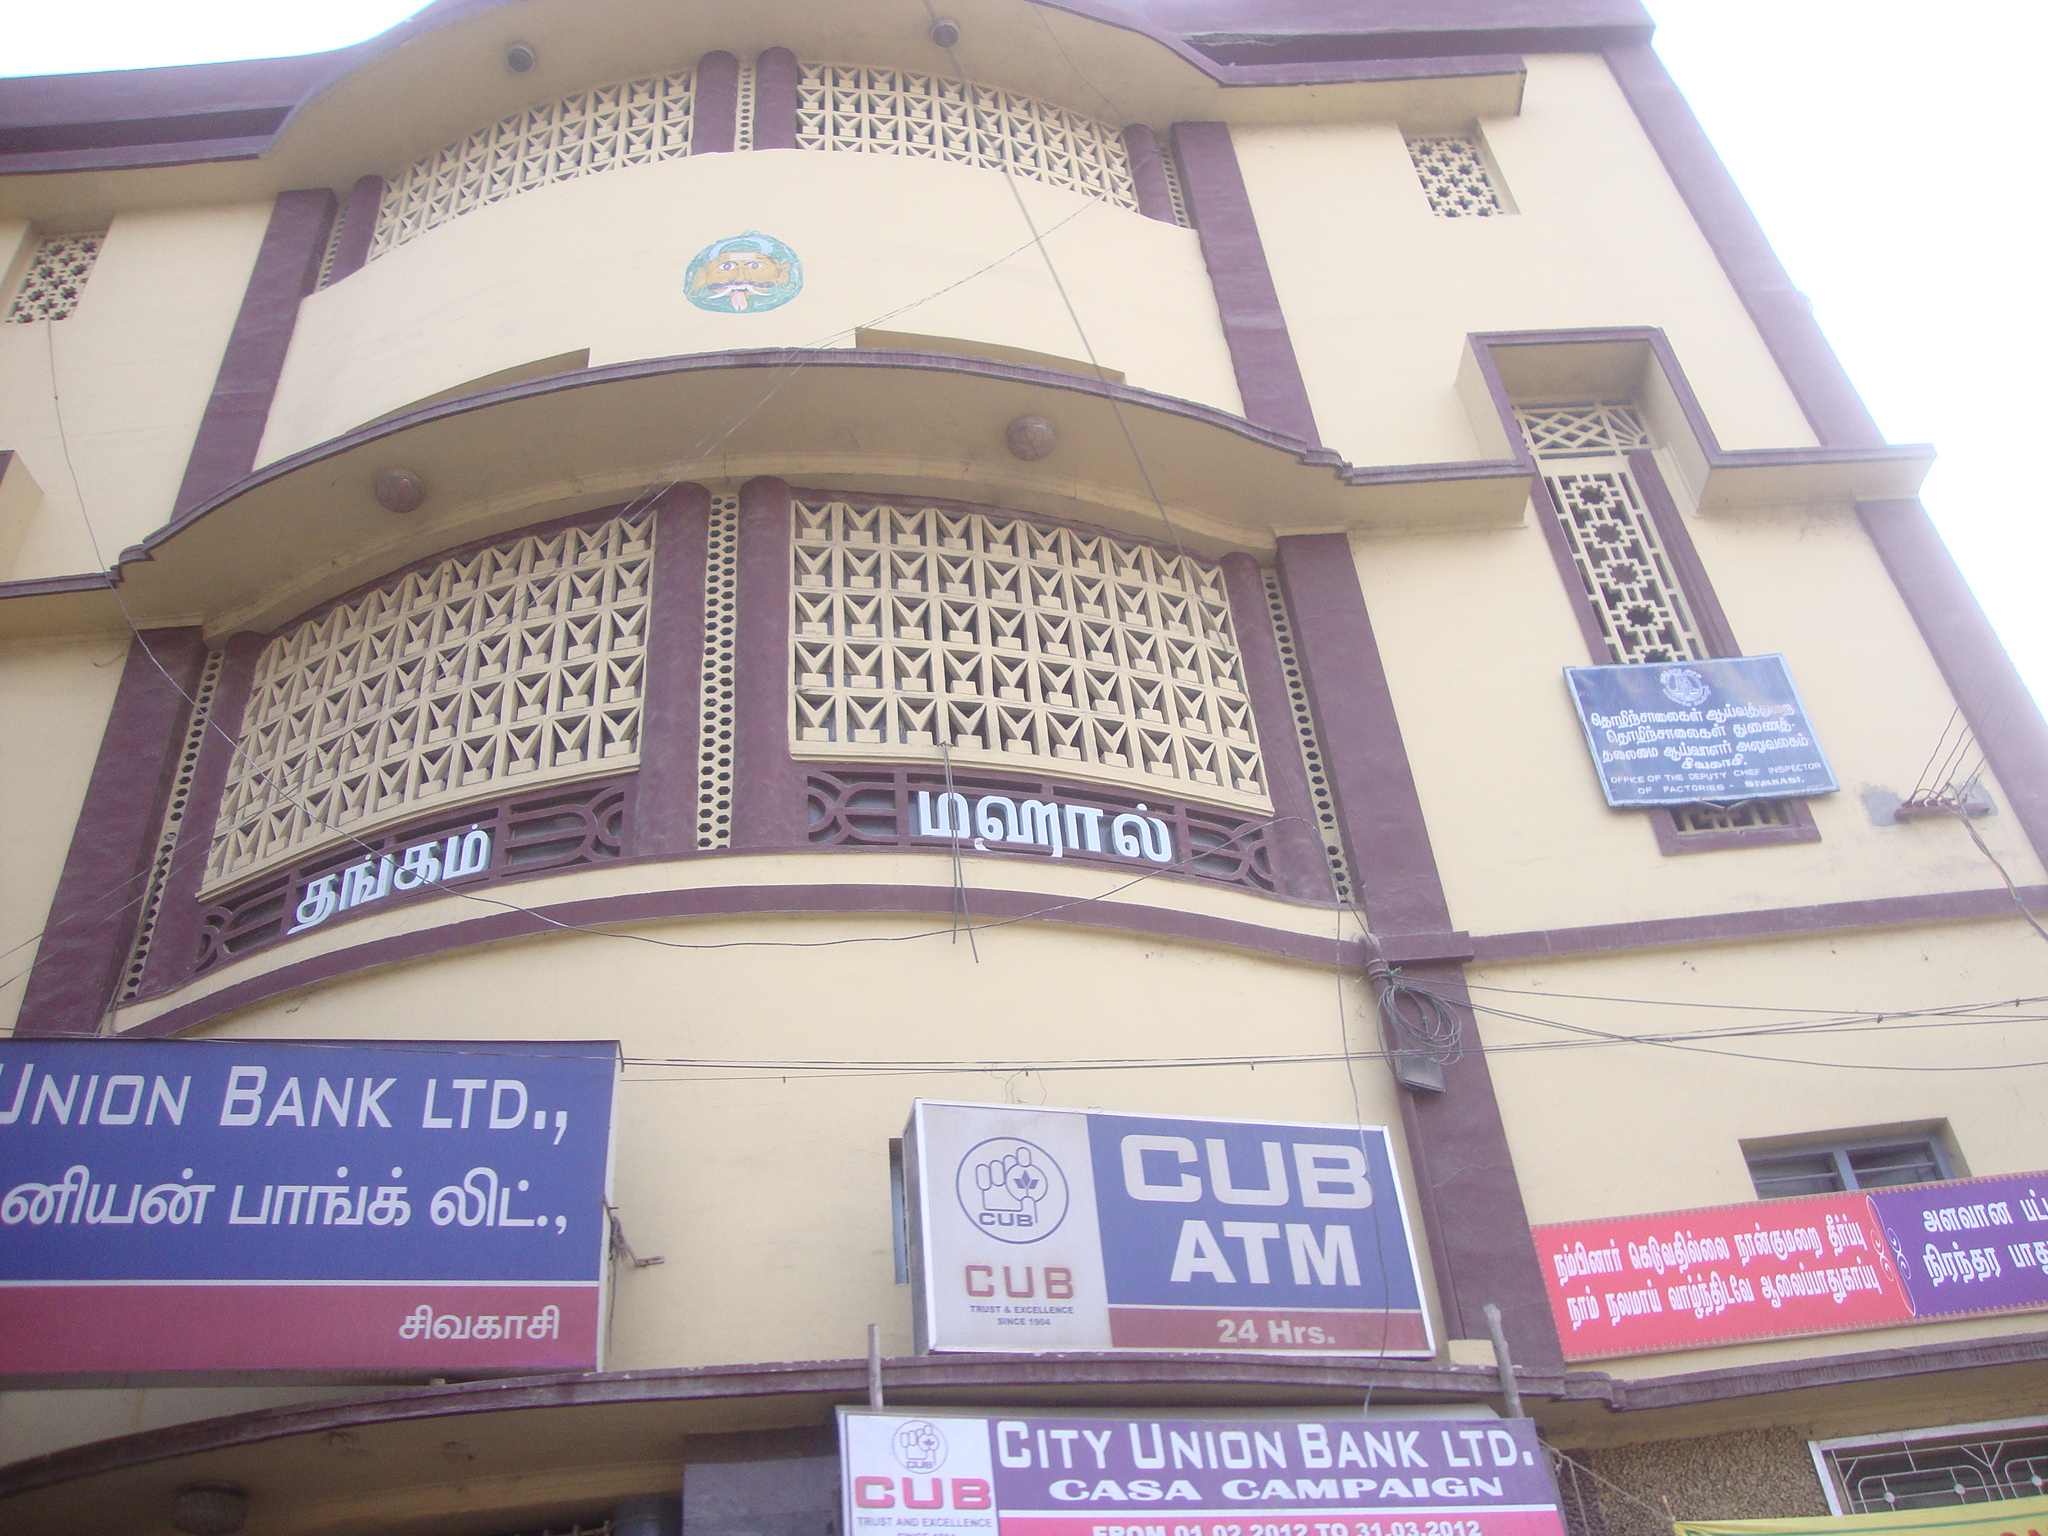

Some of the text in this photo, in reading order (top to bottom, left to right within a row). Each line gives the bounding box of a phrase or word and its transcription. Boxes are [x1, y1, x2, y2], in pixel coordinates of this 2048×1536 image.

[1610, 776, 1646, 784] OFFICE
[1688, 771, 1727, 780] DEPUTY
[1733, 768, 1760, 777] CHIEF
[1768, 762, 1821, 774] INSPECTOR
[1637, 787, 1653, 795] OF
[1662, 784, 1725, 793] FACTORIES
[286, 823, 492, 935] தங்கம்
[0, 1063, 567, 1145] UNION BANK LTD.,
[1120, 1134, 1373, 1209] CUB
[229, 1166, 411, 1226] பாங்க்
[430, 1166, 567, 1235] லிட்.,
[1922, 1202, 2014, 1232] அளவான
[979, 1212, 1033, 1227] CUB
[1170, 1219, 1362, 1286] ATM
[1553, 1238, 1623, 1286] நம்பினார்
[1922, 1241, 2001, 1287] நிரந்தர
[965, 1264, 1074, 1299] CUB
[399, 1304, 560, 1340] சிவகாசி
[969, 1305, 1001, 1314] TRUST
[1014, 1306, 1075, 1314] EXCELLENCE
[997, 1317, 1026, 1326] SINCE
[1566, 1285, 1600, 1330] நாம்
[1605, 1279, 1663, 1326] நலமாய்
[1216, 1319, 1336, 1344] 24 Hrs.
[997, 1420, 1534, 1469] CITY UNION BANK LTD.
[854, 1475, 992, 1510] CUB
[1049, 1476, 1503, 1501] CASA CAMPAIGN
[857, 1516, 993, 1527] TRUST AND EXCELLENCE
[1174, 1523, 1308, 1536] 01022012
